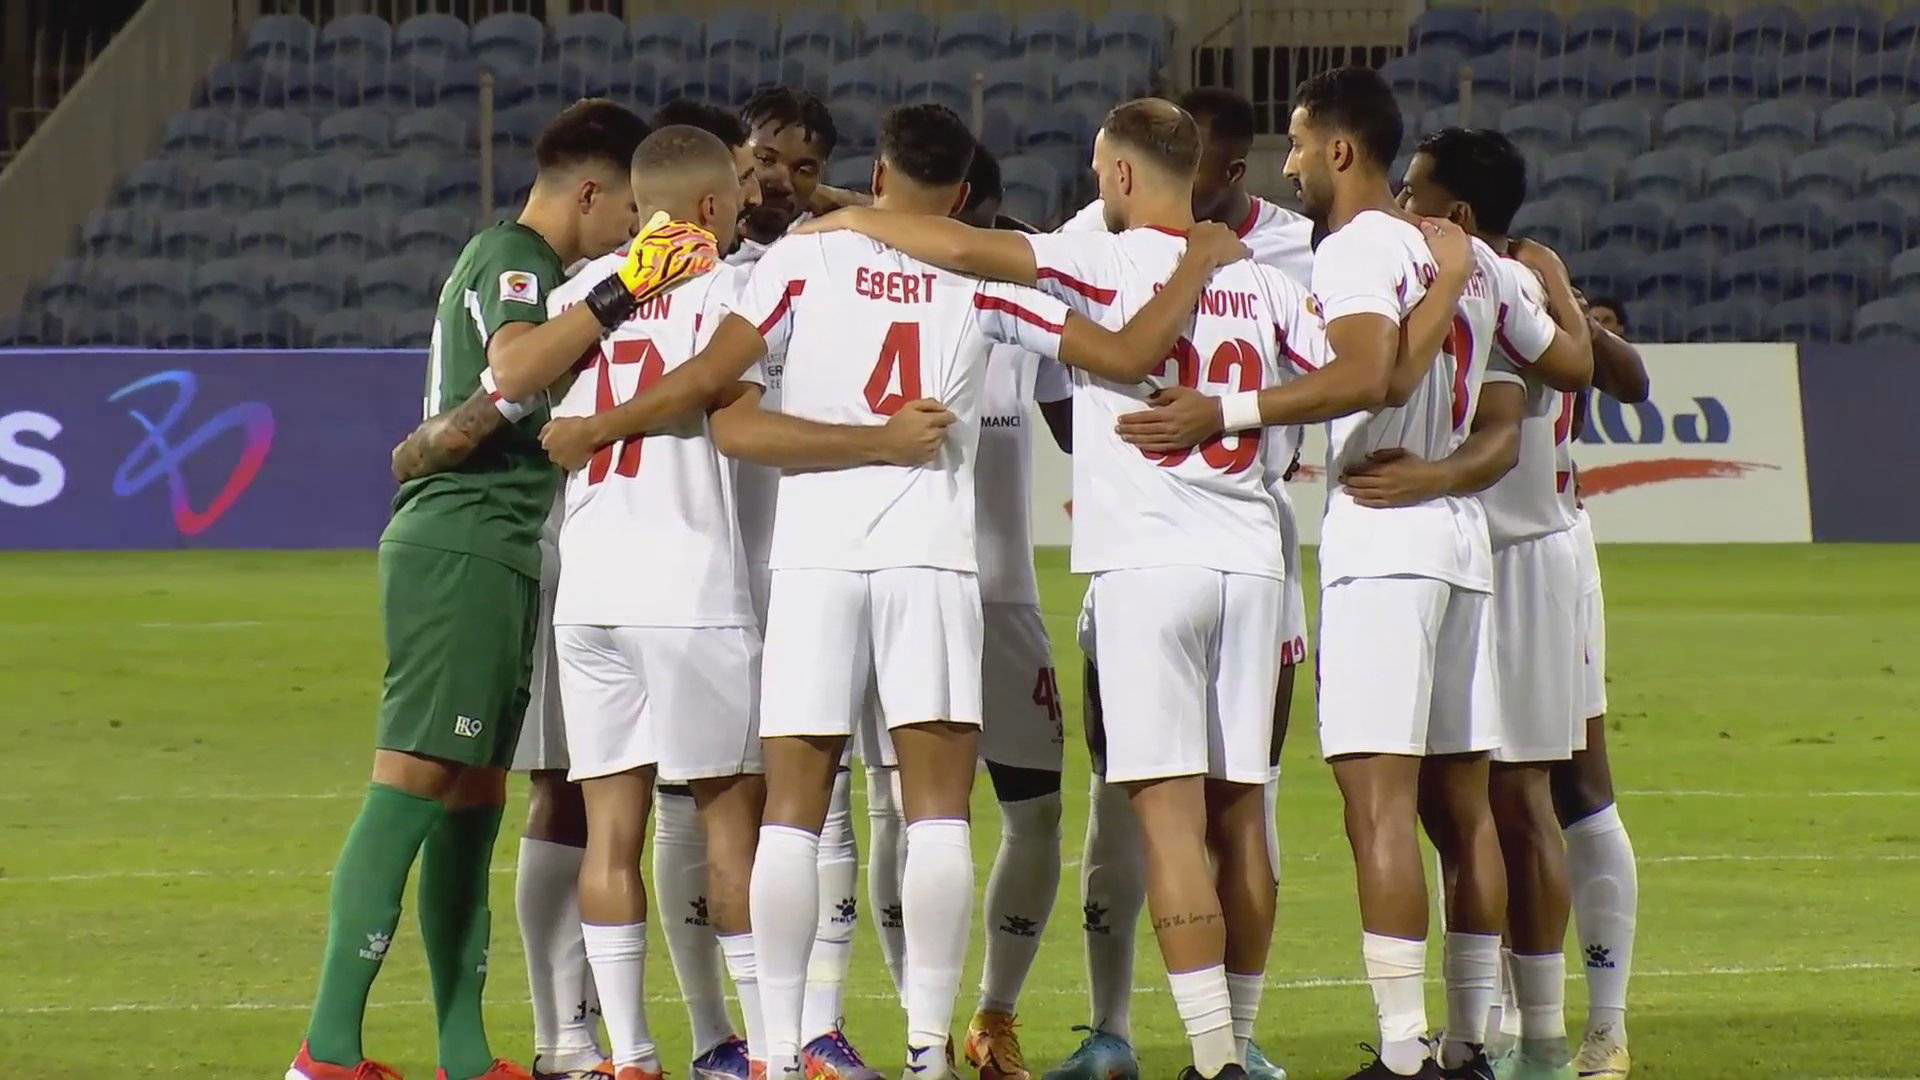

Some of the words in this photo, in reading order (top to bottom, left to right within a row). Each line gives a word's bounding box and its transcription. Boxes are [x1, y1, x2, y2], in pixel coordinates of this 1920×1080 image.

[856, 266, 937, 304] EBERT
[863, 321, 922, 416] 4
[570, 338, 666, 486] 17
[684, 916, 710, 927] KEL
